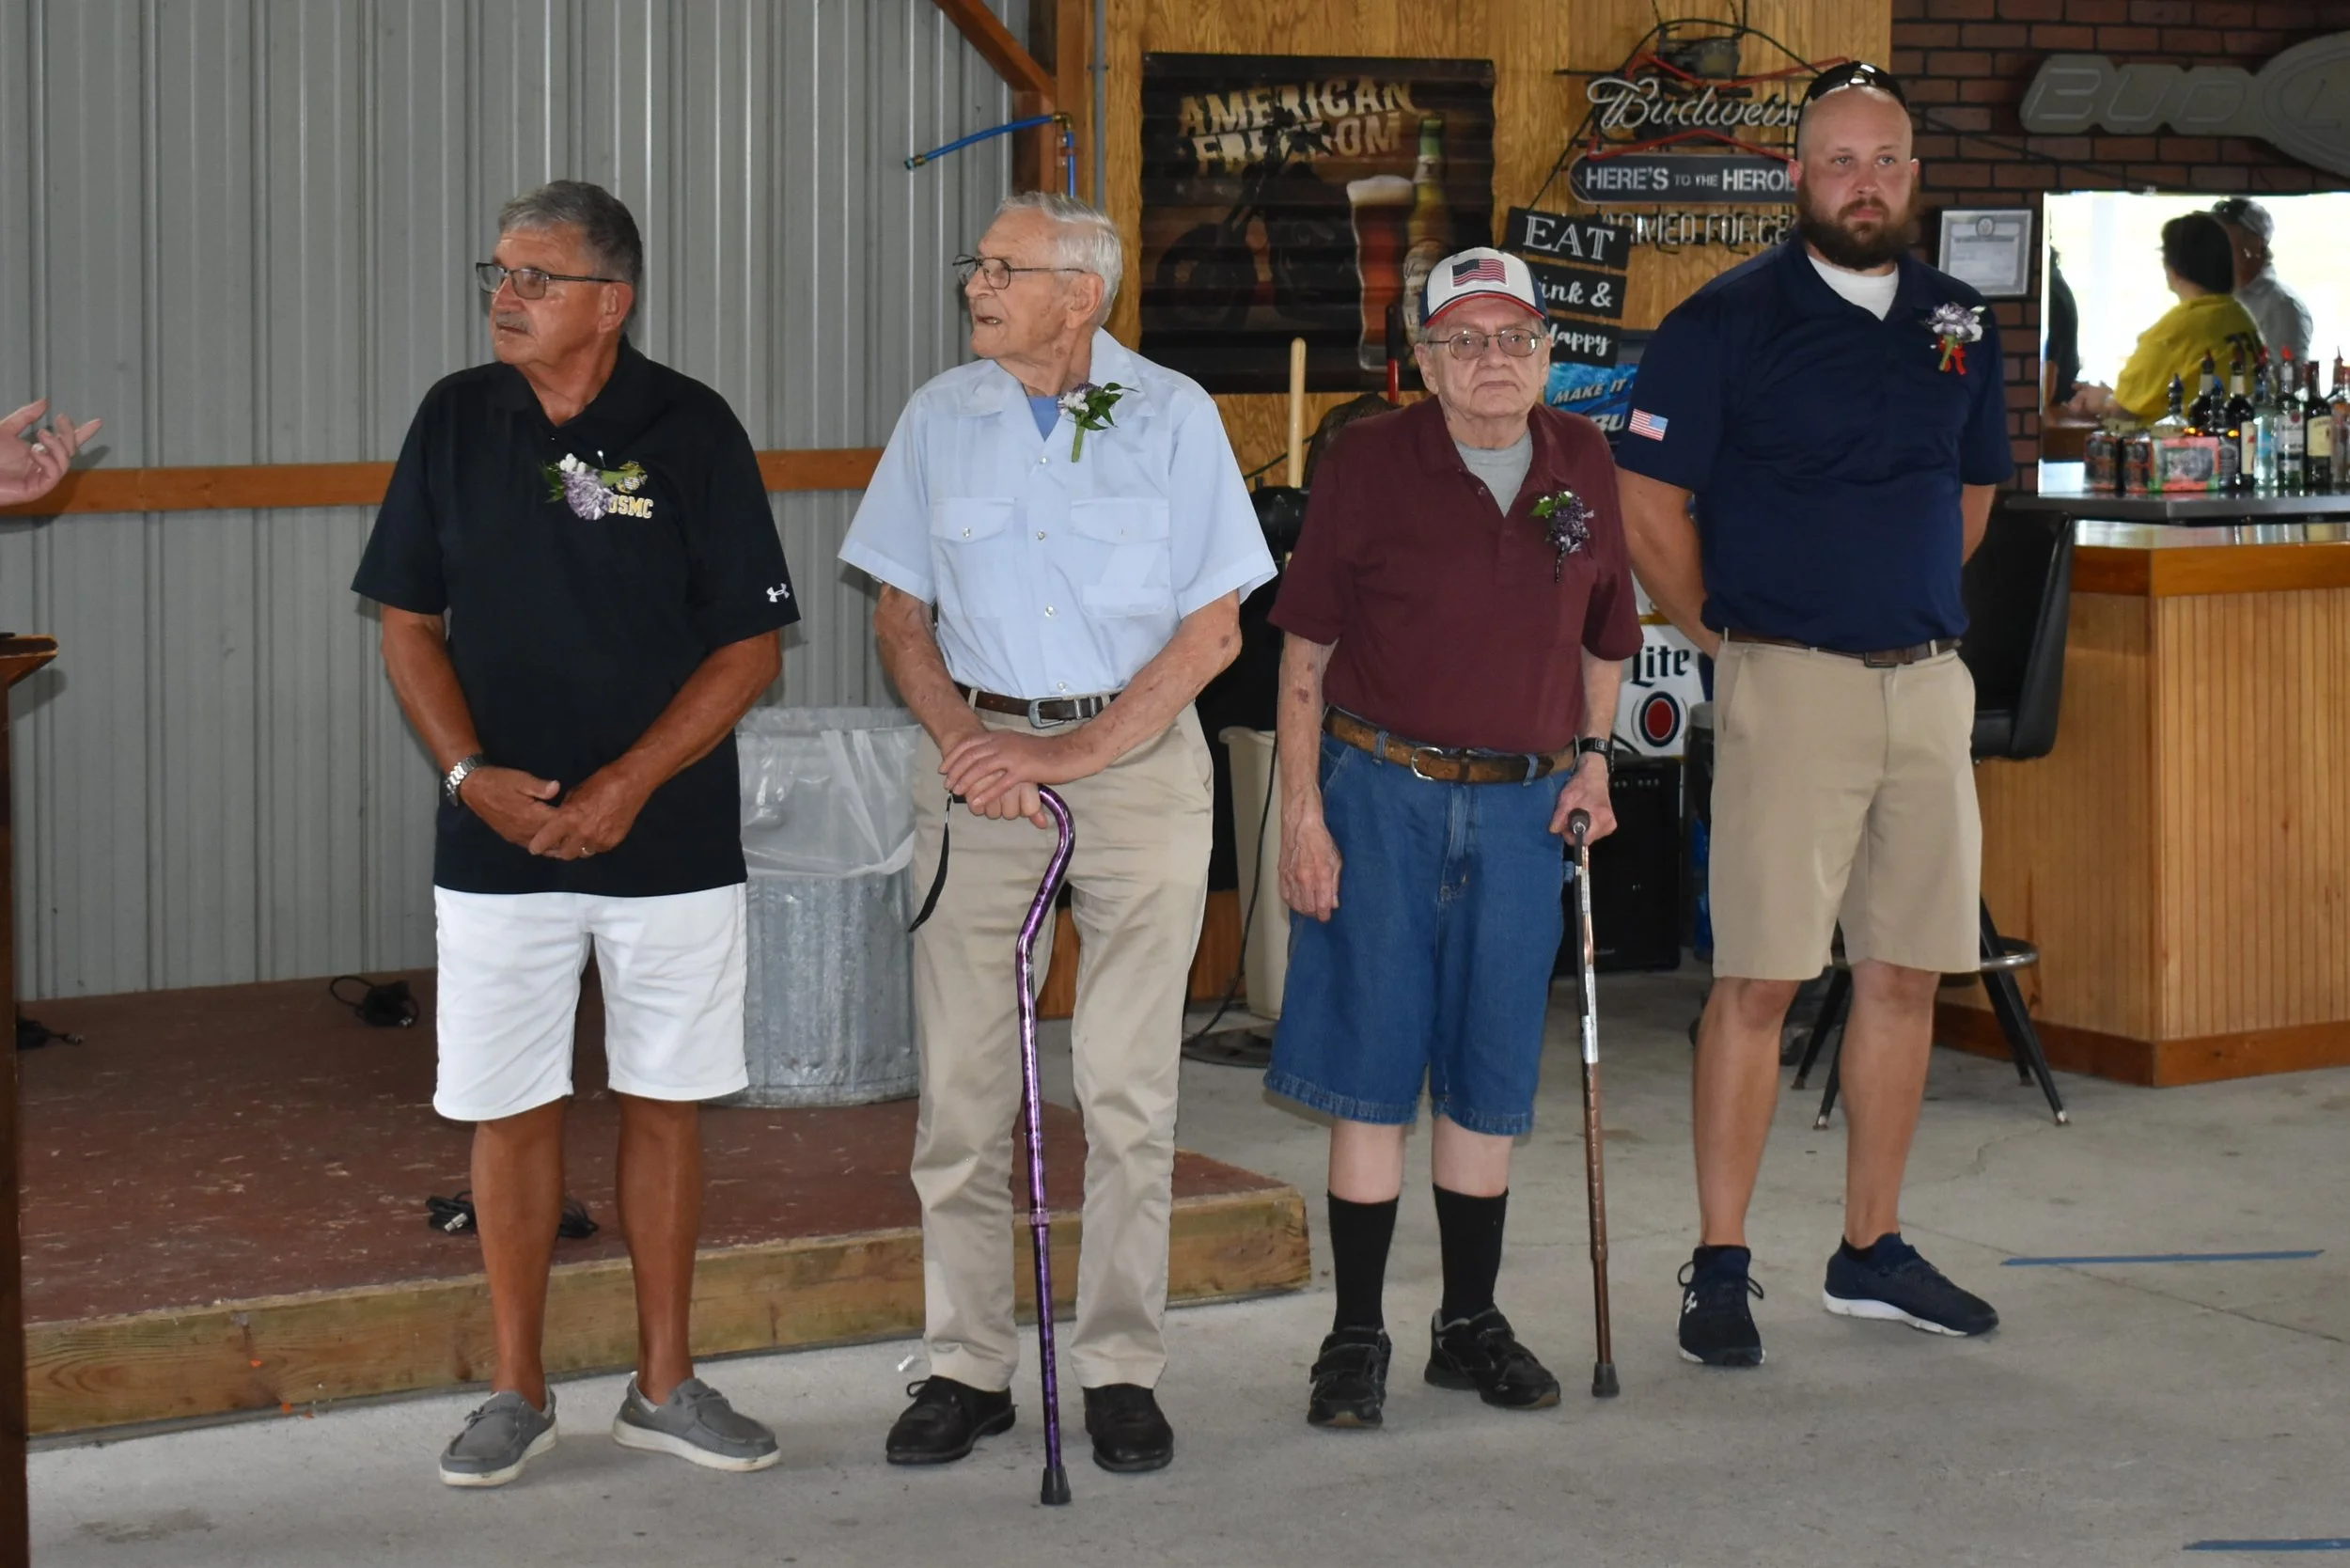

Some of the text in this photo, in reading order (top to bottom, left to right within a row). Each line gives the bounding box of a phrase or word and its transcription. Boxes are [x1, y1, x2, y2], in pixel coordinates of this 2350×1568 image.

[1179, 77, 1425, 136] AMERICAN
[1192, 111, 1402, 169] FREOM
[1586, 166, 1669, 191] HERE'S
[1673, 174, 1691, 187] TO
[1523, 215, 1615, 261] EAT
[1539, 275, 1584, 305] ink
[1552, 383, 1606, 405] MAKE
[1609, 378, 1627, 394] IT
[607, 494, 653, 518] USMC
[1631, 645, 1690, 687] Lite
